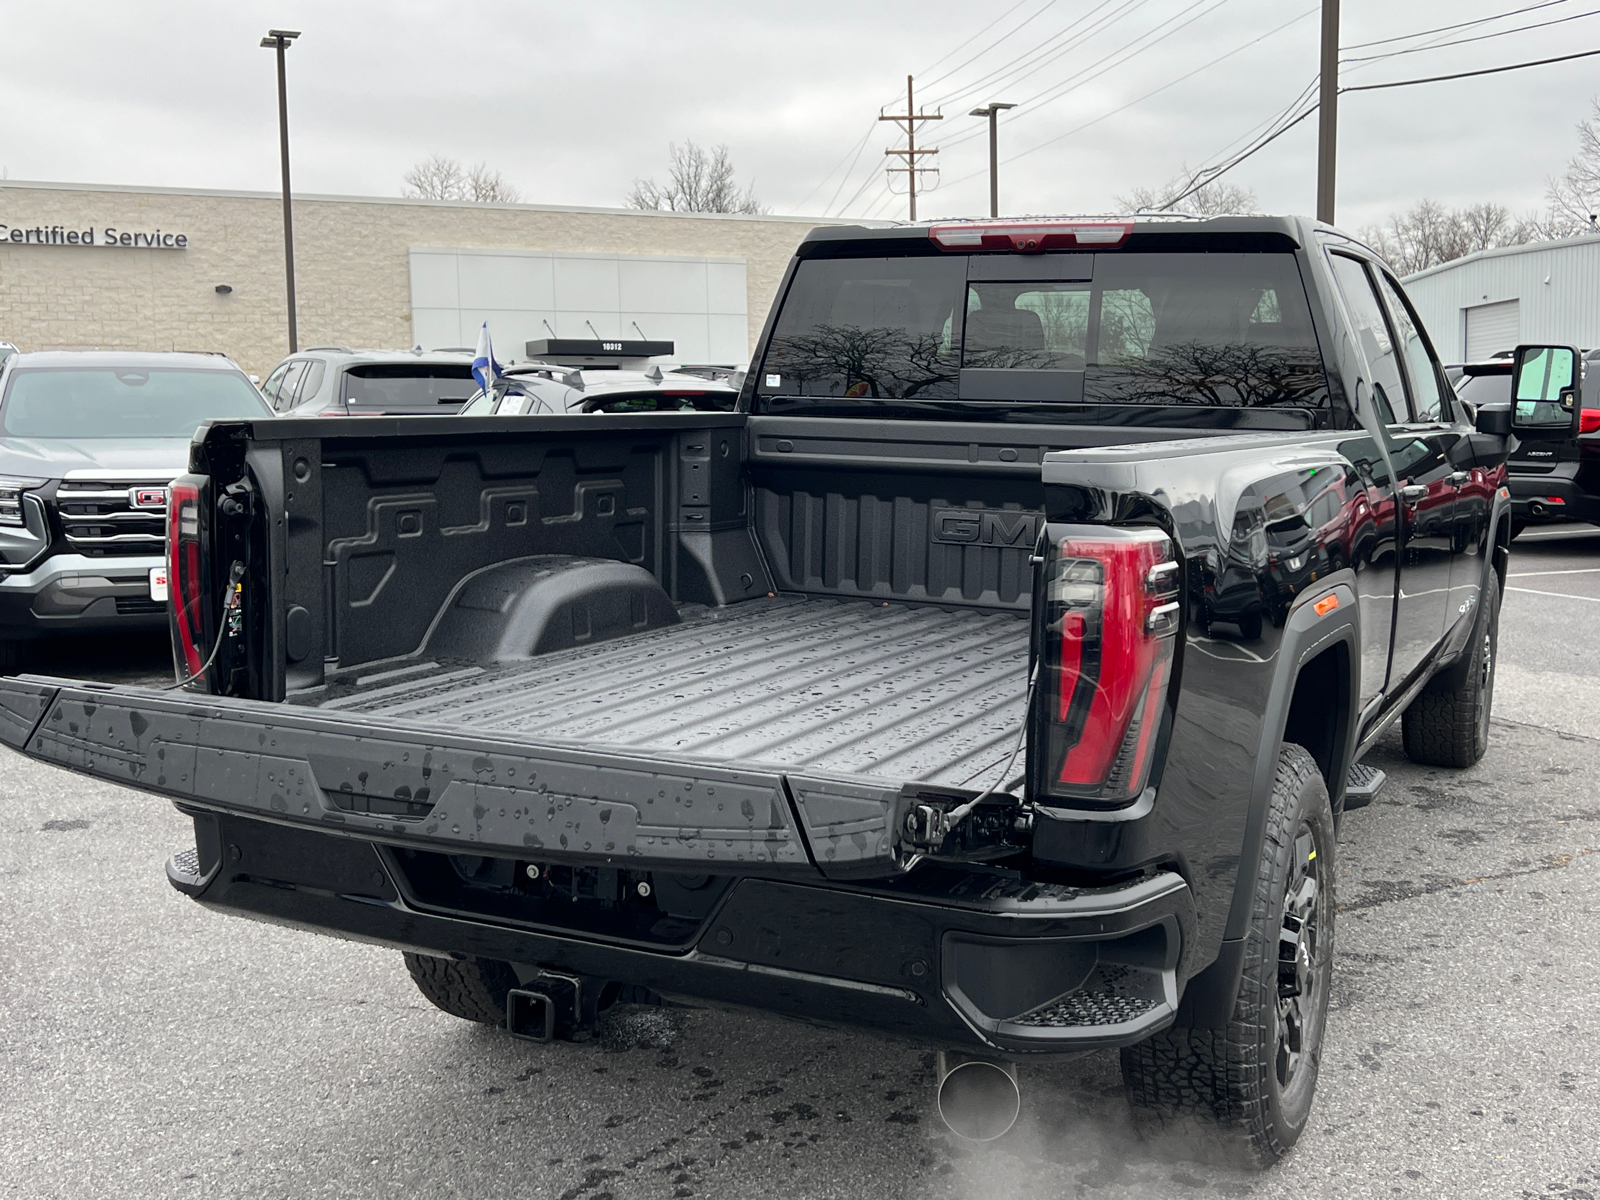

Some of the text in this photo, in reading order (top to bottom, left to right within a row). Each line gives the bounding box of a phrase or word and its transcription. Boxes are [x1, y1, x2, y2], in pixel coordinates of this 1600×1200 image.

[0, 224, 188, 247] Certified Service
[602, 342, 622, 351] 10312
[138, 490, 168, 505] G
[934, 511, 1044, 546] GM
